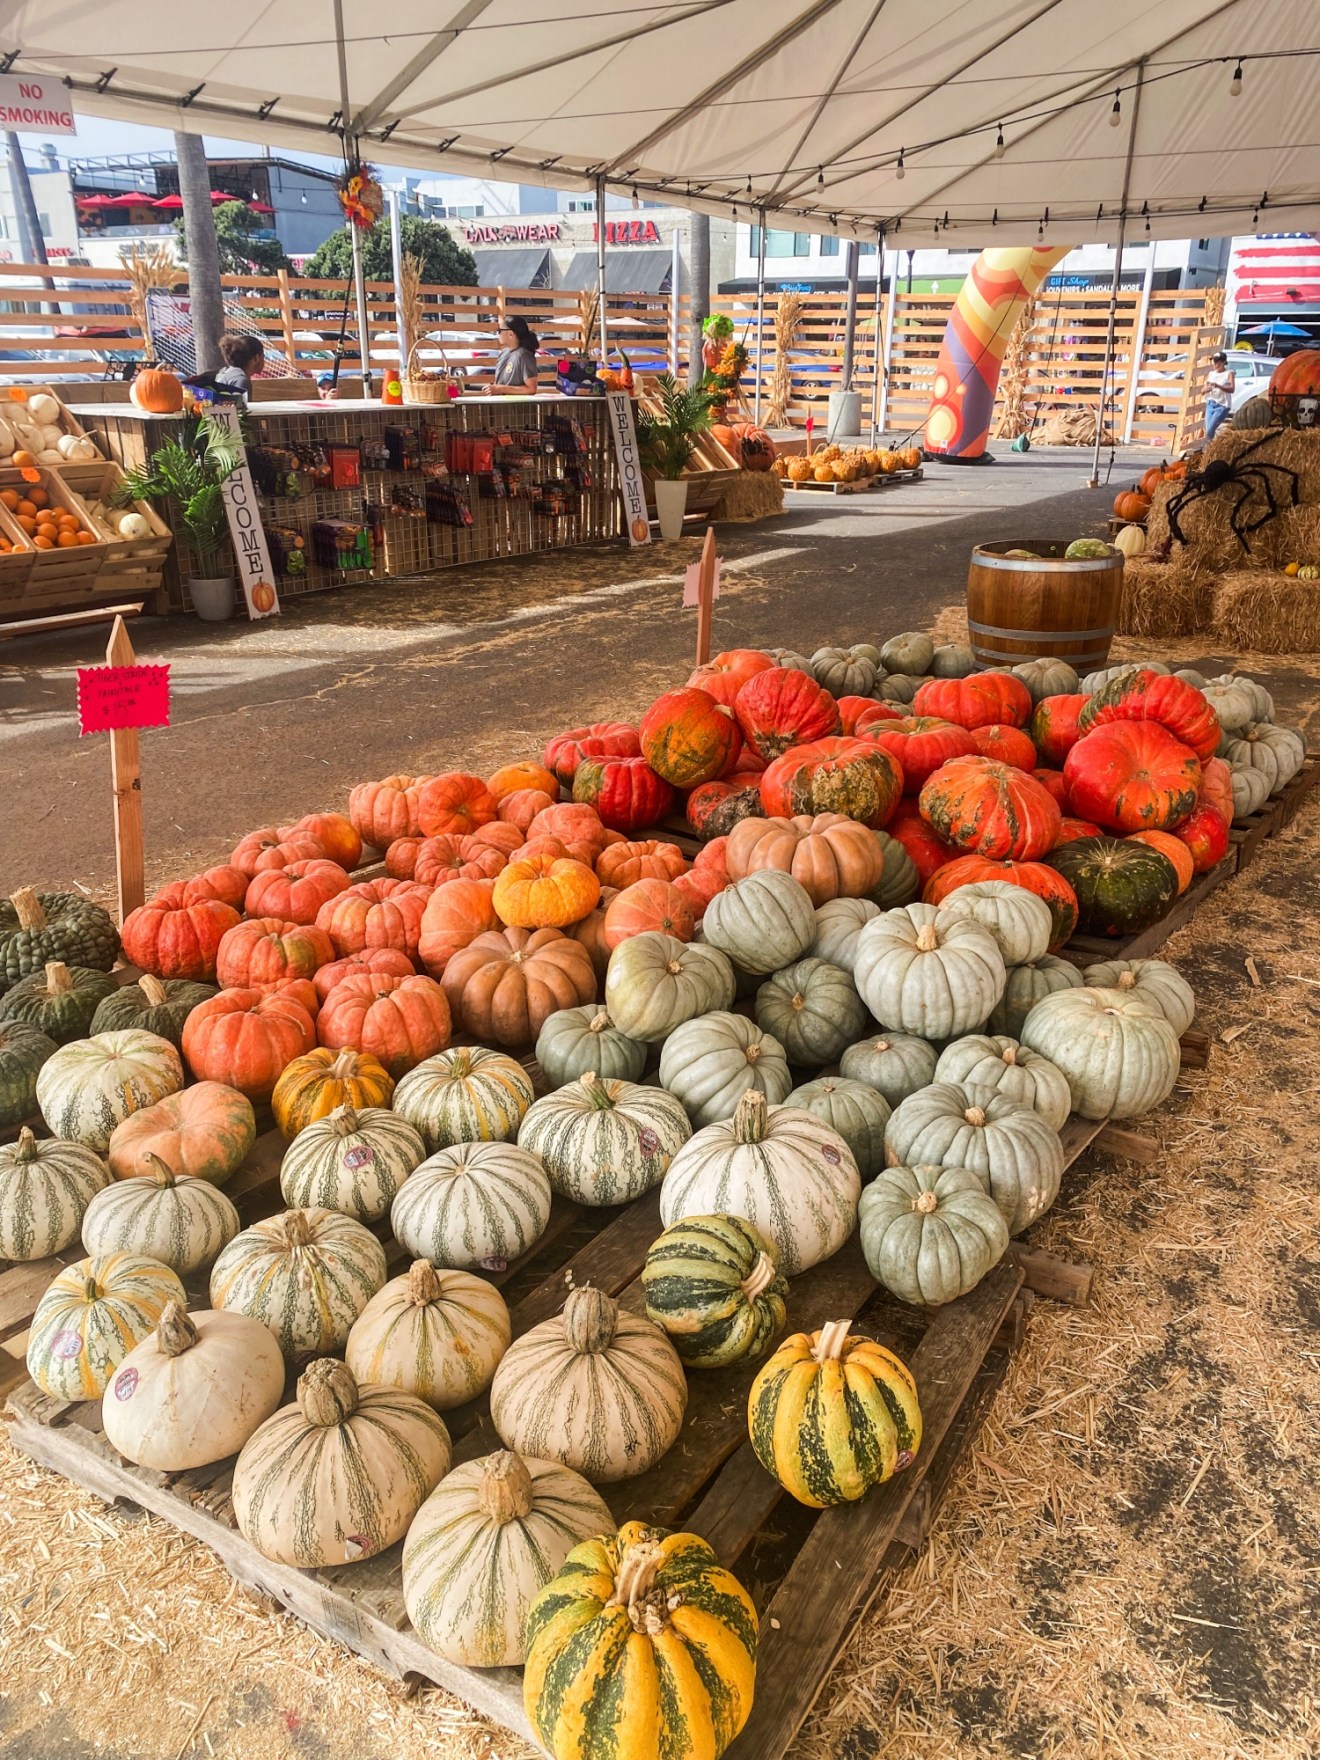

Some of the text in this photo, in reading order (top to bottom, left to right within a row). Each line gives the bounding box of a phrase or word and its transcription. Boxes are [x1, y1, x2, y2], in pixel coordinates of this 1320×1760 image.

[18, 83, 43, 100] NO
[0, 106, 72, 128] SMOKING
[517, 223, 560, 240] WEAR
[1050, 276, 1090, 288] GIFT Shop
[1120, 284, 1140, 292] MORE
[612, 396, 642, 514] WELCOME
[210, 413, 264, 575] WLCOME
